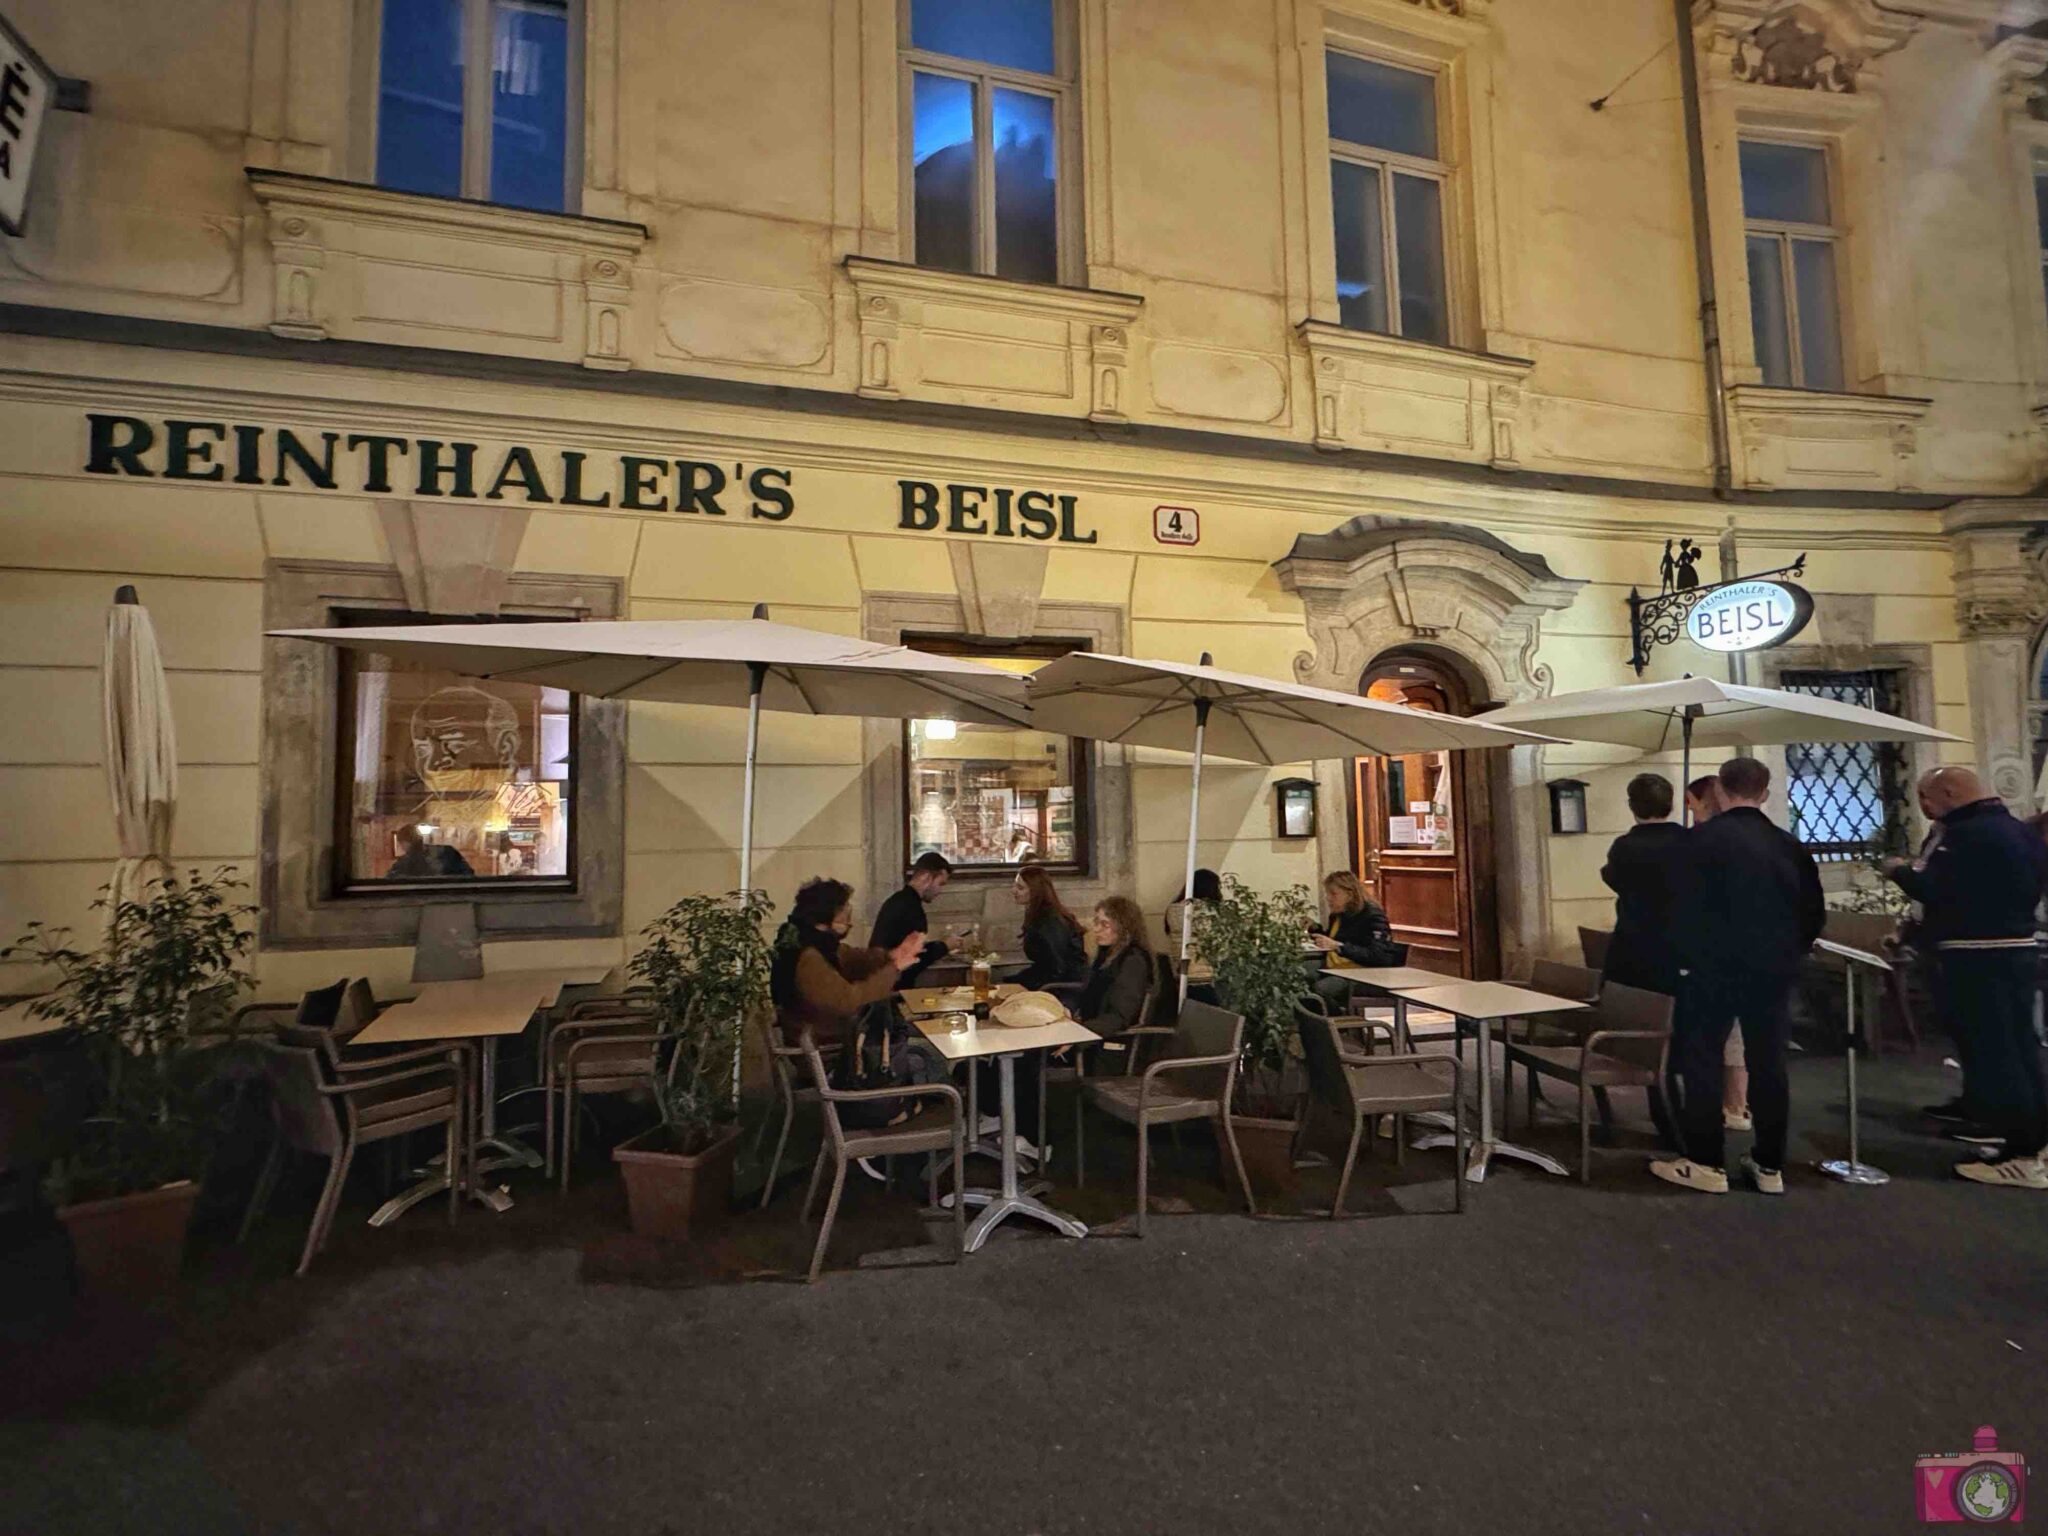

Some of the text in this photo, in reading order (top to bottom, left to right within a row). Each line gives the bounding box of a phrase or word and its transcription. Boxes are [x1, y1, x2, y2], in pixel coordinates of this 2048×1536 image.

[84, 413, 1098, 544] REINTHALER'S BEISL
[1168, 510, 1183, 533] 4
[1697, 600, 1784, 639] BEISL
